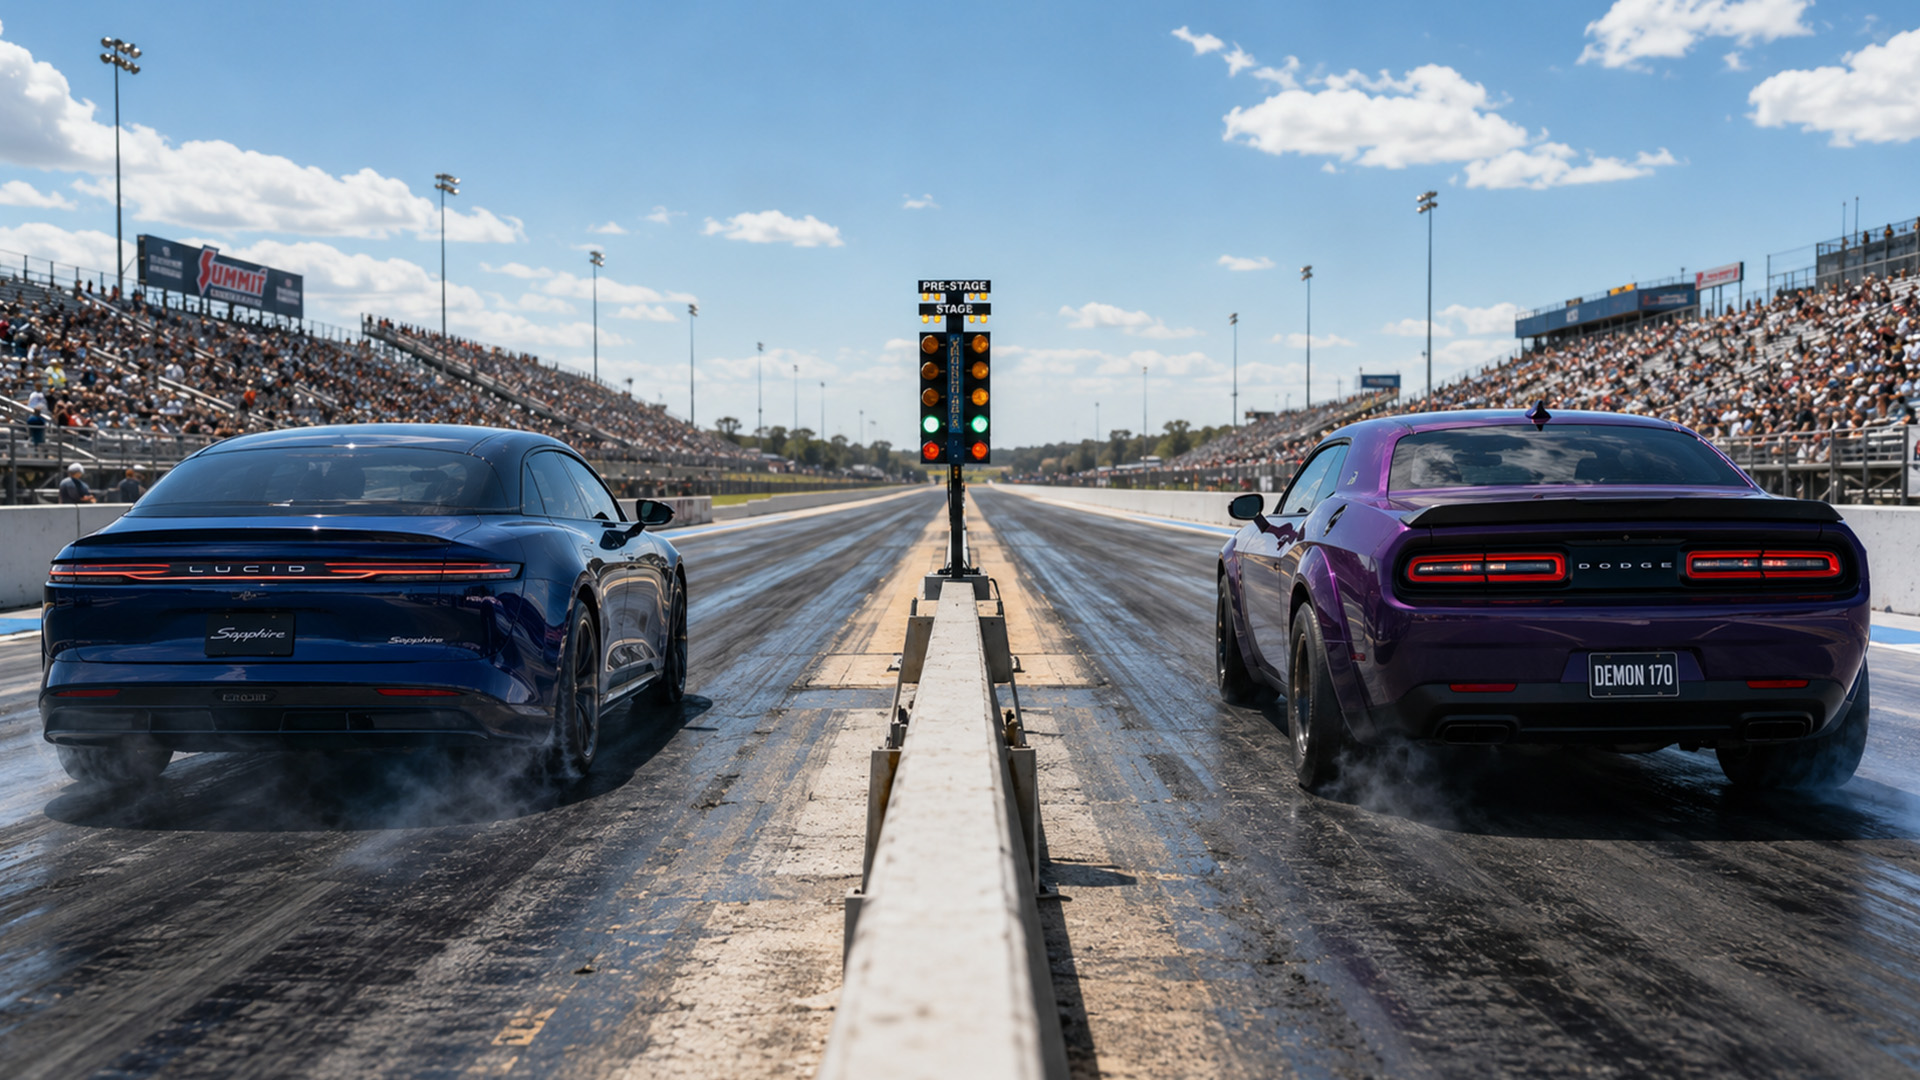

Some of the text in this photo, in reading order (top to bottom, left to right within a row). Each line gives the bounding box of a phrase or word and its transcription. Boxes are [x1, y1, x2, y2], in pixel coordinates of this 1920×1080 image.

[198, 247, 267, 295] SUMMIT
[922, 281, 987, 291] PRE-STAGE
[935, 304, 973, 314] STAGE
[189, 565, 305, 573] LUCID
[210, 627, 286, 642] Sapphire
[388, 636, 443, 645] Sapphire
[1595, 665, 1673, 686] DEMON 170
